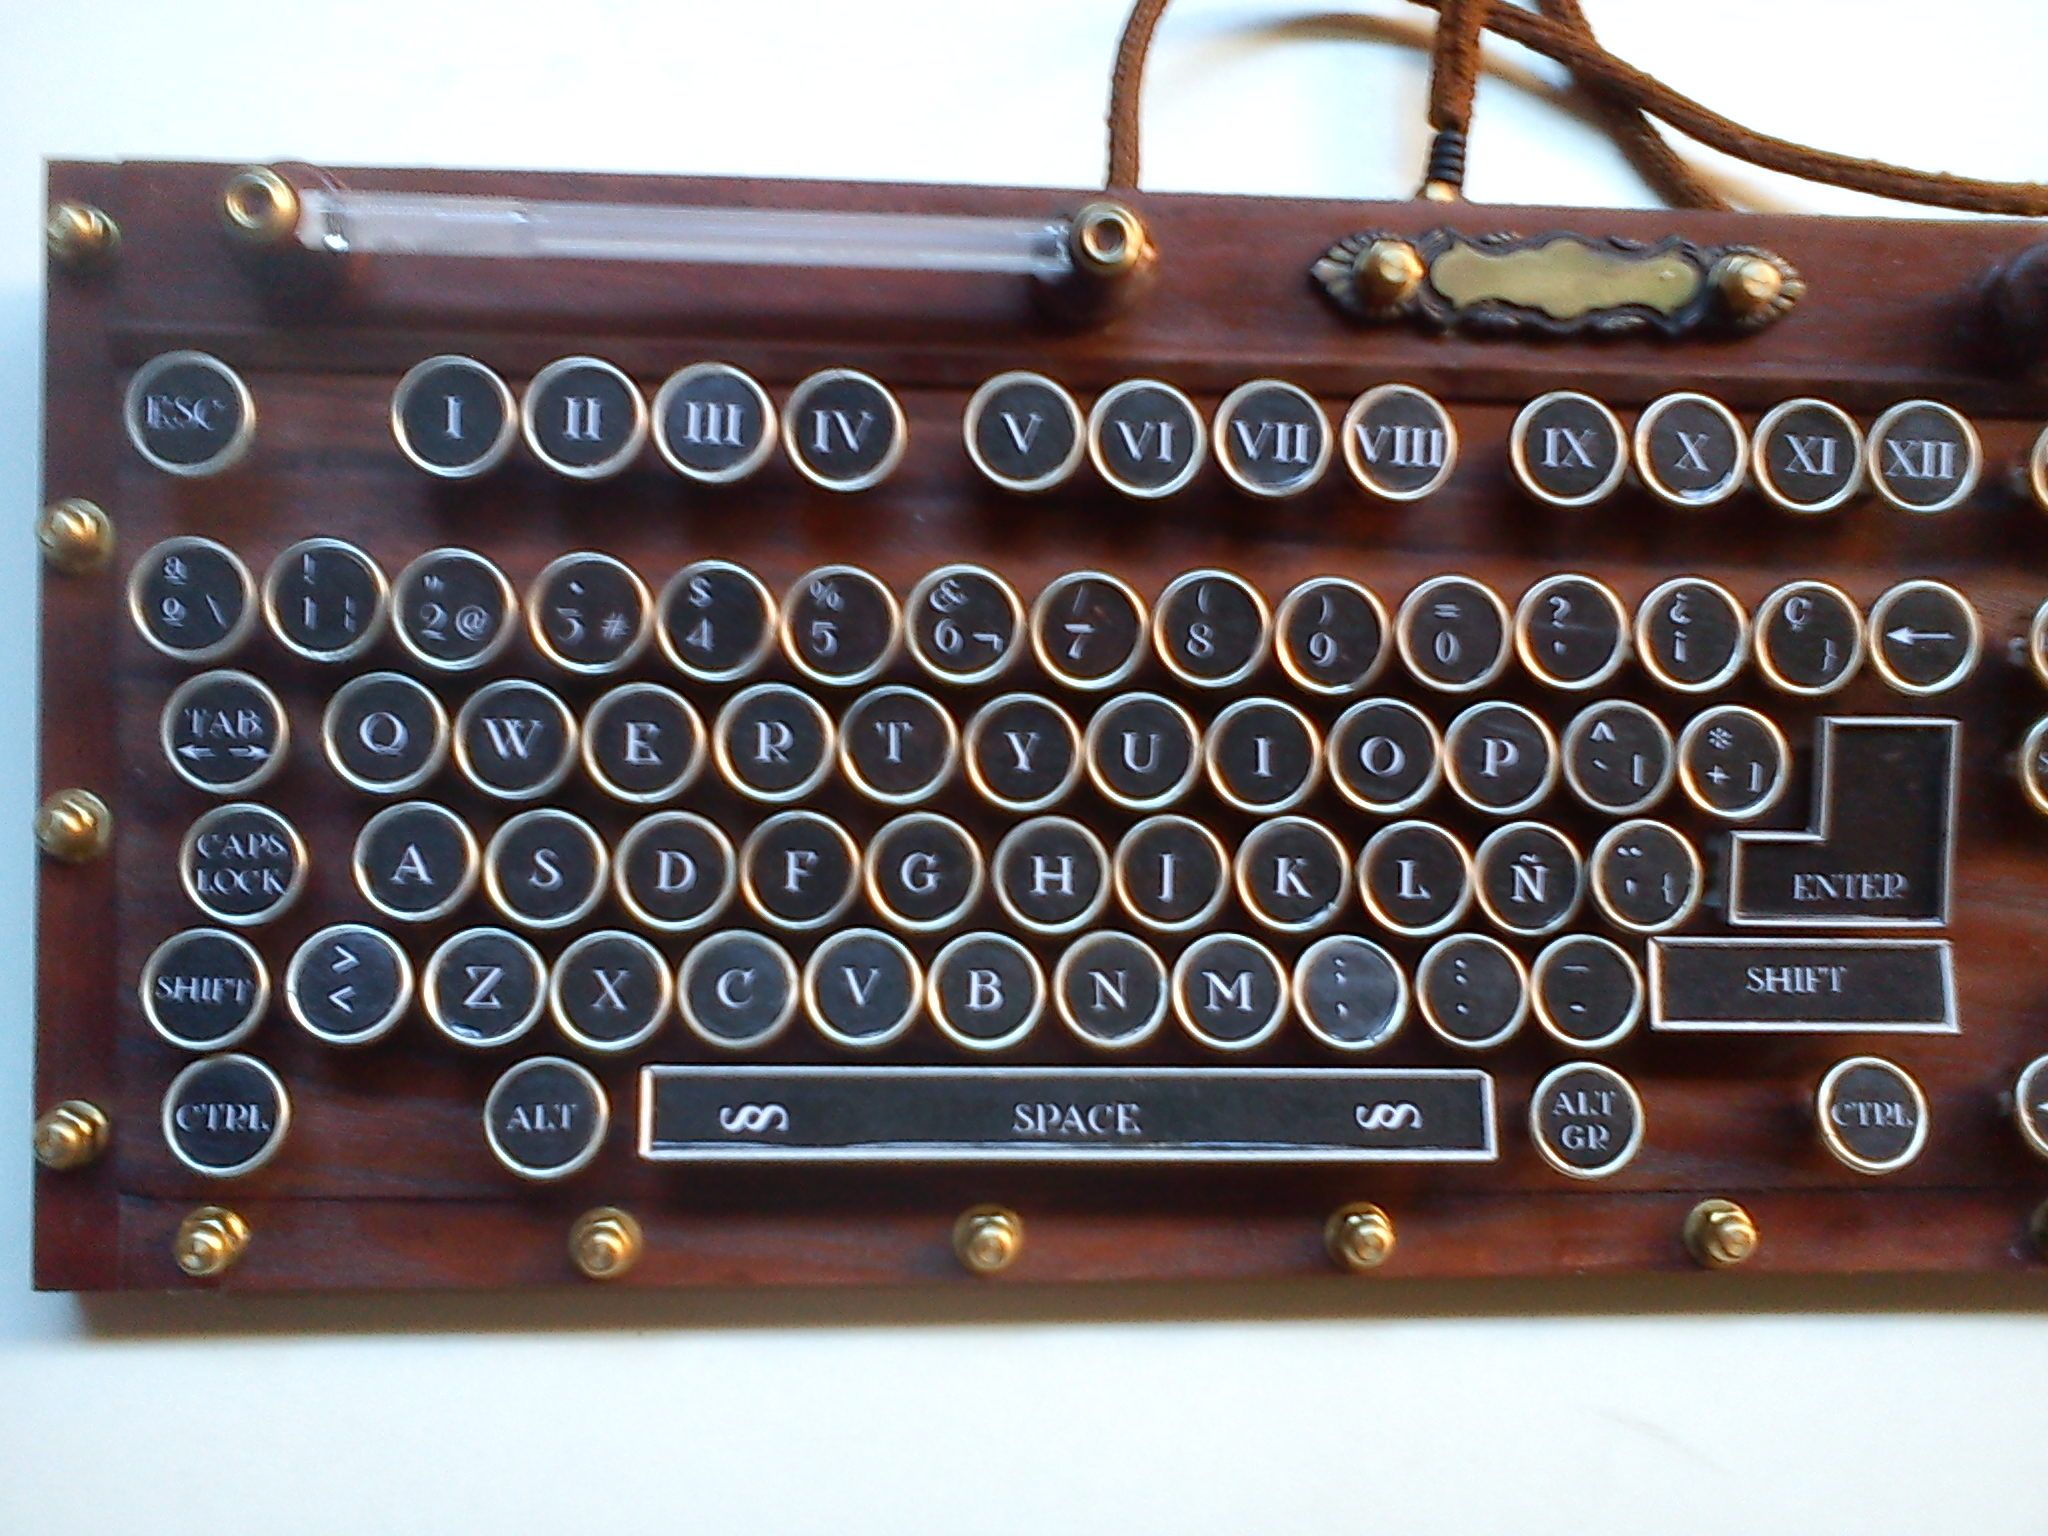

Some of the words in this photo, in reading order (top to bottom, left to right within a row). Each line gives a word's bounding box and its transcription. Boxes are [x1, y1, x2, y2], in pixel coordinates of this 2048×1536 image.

[145, 395, 225, 431] ESC
[446, 396, 462, 439] I
[565, 396, 601, 441] II
[684, 401, 742, 446] III
[814, 410, 873, 453] IV
[1002, 413, 1042, 453] V
[1115, 420, 1173, 462] VI
[1231, 419, 1310, 464] VII
[1355, 422, 1443, 467] VIII
[1542, 427, 1595, 468] IX
[1674, 431, 1709, 472] X
[1784, 434, 1837, 476] XI
[1885, 439, 1956, 480] XII
[689, 576, 711, 607] $
[809, 580, 843, 612] %
[929, 579, 967, 613] &
[421, 603, 447, 641] 2
[455, 604, 490, 641] @
[601, 612, 629, 640] #
[1549, 596, 1571, 629] ?
[685, 618, 713, 651] 4
[811, 620, 837, 654] 5
[934, 618, 962, 653] 6
[1064, 623, 1095, 659] 7
[1187, 623, 1214, 656] 8
[1309, 632, 1337, 665] 9
[1435, 631, 1460, 663] 0
[184, 709, 263, 738] TAB
[359, 712, 407, 753] Q
[483, 718, 541, 758] W
[625, 722, 660, 764] E
[755, 721, 793, 763] R
[875, 721, 913, 763] T
[1004, 732, 1038, 772] Y
[1123, 732, 1158, 773] U
[1256, 737, 1271, 777] I
[1360, 736, 1405, 775] O
[1482, 738, 1519, 777] P
[196, 832, 289, 859] CAPS
[391, 844, 433, 884] A
[196, 868, 287, 895] LOCK
[529, 848, 562, 887] S
[656, 850, 696, 892] D
[784, 850, 817, 892] F
[900, 852, 938, 893] G
[1030, 856, 1074, 895] H
[1158, 853, 1174, 902] J
[1275, 857, 1312, 898] K
[1397, 860, 1431, 899] L
[1511, 854, 1548, 903] Ñ
[1793, 873, 1907, 901] ENTER
[155, 975, 253, 1004] SHIFT
[463, 966, 503, 1009] Z
[592, 969, 628, 1011] X
[716, 968, 754, 1009] C
[843, 967, 879, 1006] V
[966, 969, 1003, 1011] B
[1088, 971, 1126, 1010] N
[1202, 971, 1253, 1012] M
[1746, 966, 1847, 993] SHIFT
[175, 1102, 273, 1134] CTRL
[506, 1103, 577, 1131] ALT
[1012, 1103, 1141, 1135] SPACE
[1552, 1090, 1616, 1116] ALT
[1831, 1101, 1913, 1129] CTRL
[1561, 1124, 1609, 1150] GR
